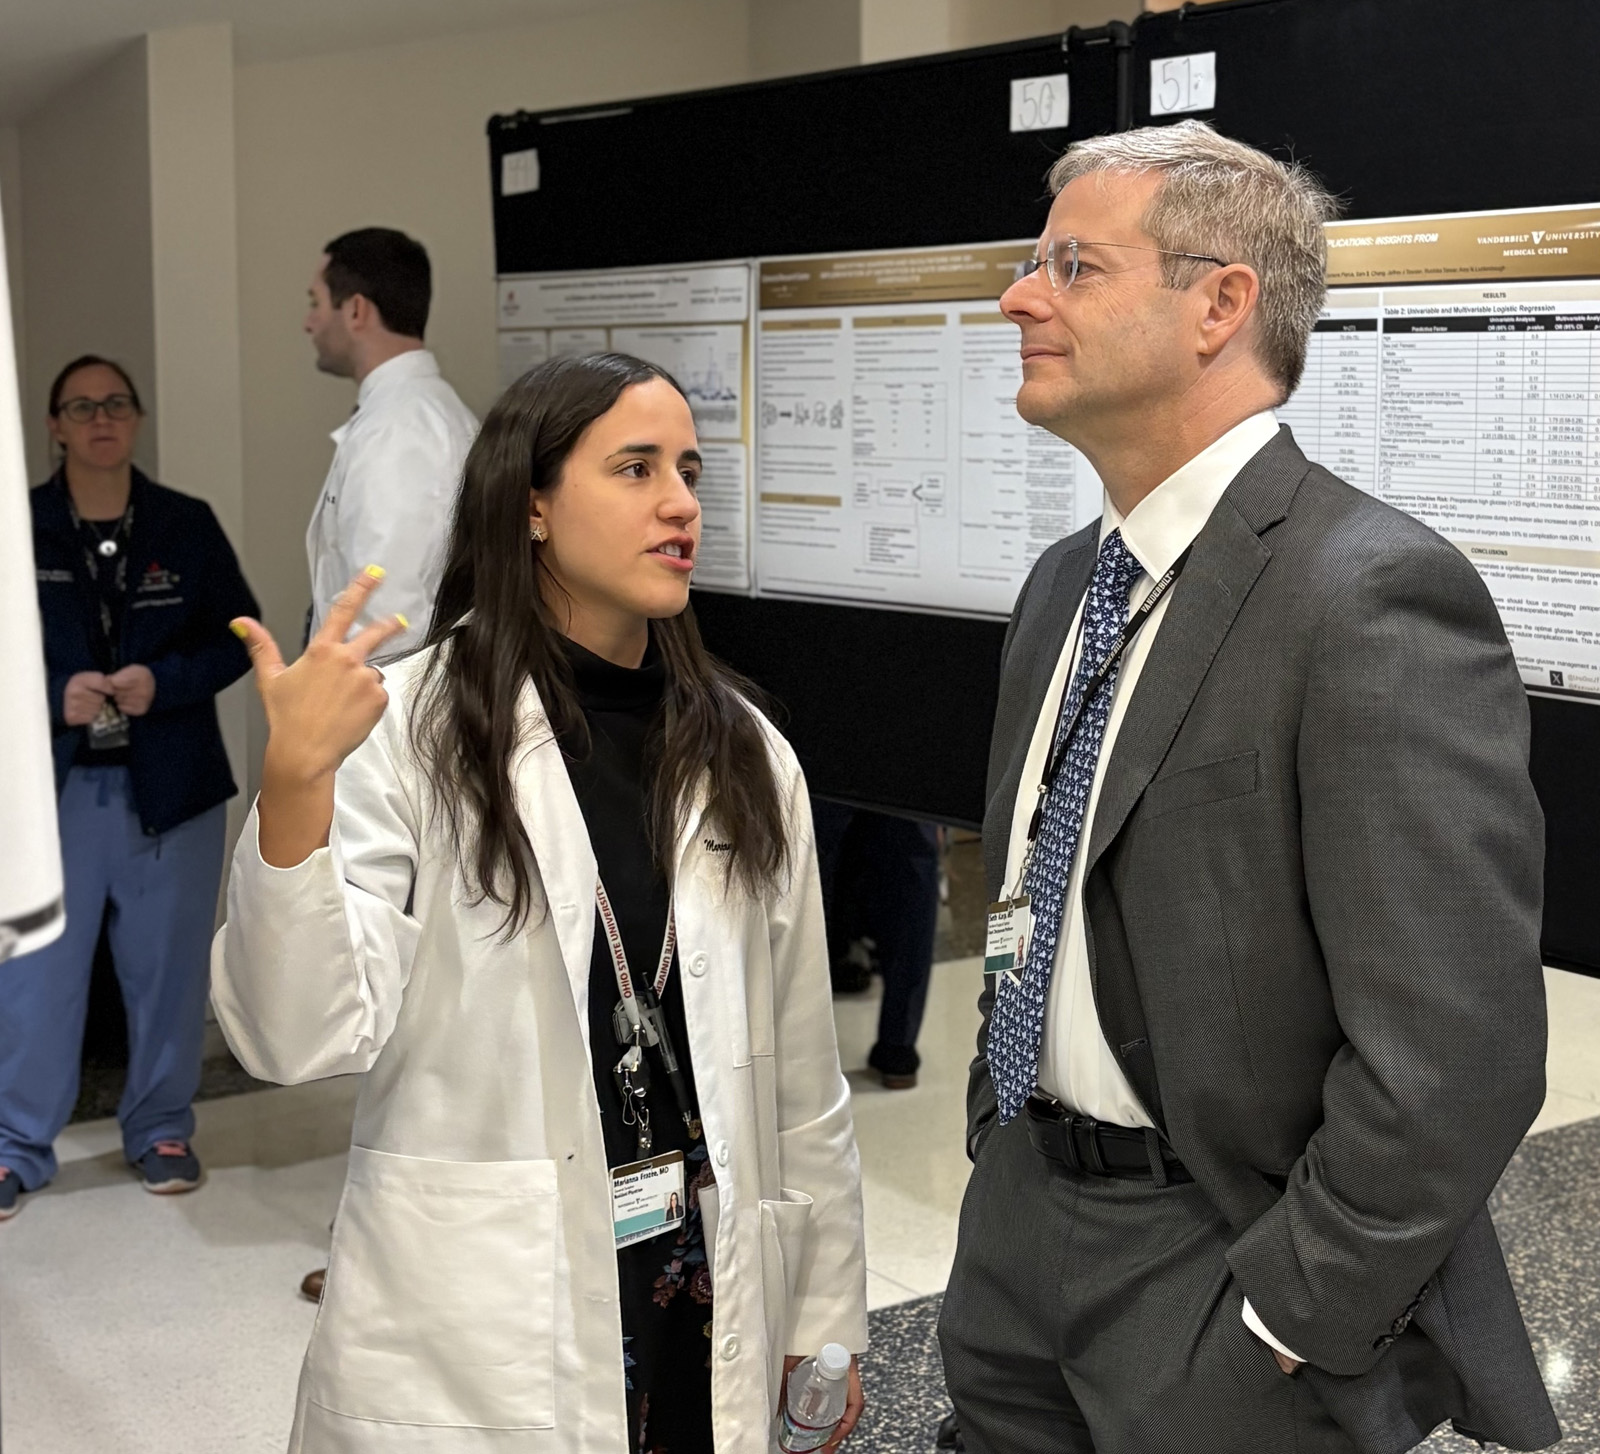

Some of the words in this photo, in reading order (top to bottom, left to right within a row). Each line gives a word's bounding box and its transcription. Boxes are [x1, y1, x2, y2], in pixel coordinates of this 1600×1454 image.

[1375, 234, 1413, 245] INSIGHTS
[1413, 232, 1439, 244] FROM
[1477, 234, 1530, 245] VANDERBILT
[1545, 231, 1600, 242] UNIVERSITY
[1503, 247, 1536, 257] MEDICAL
[1537, 246, 1569, 255] CENTER
[1482, 291, 1506, 299] RESULTS
[1384, 306, 1399, 315] Table
[1407, 305, 1440, 315] Univariable
[1440, 306, 1452, 314] and
[1453, 304, 1491, 314] Multivariable
[1492, 304, 1517, 314] Logistic
[1518, 303, 1555, 313] Regression
[1470, 547, 1508, 557] CONCLUSIONS
[1505, 565, 1529, 573] significant
[1529, 566, 1557, 574] association
[1558, 568, 1579, 577] between
[1140, 574, 1173, 613] VANDERBILT
[1551, 601, 1576, 610] optimizing
[1534, 625, 1552, 633] optimal
[1554, 627, 1574, 635] glucose
[1533, 632, 1564, 641] complication
[1581, 637, 1592, 645] This
[1536, 657, 1555, 665] glucose
[1557, 660, 1589, 669] management
[613, 943, 627, 972] STATE
[620, 972, 632, 999] OHIO
[659, 1166, 669, 1175] MD
